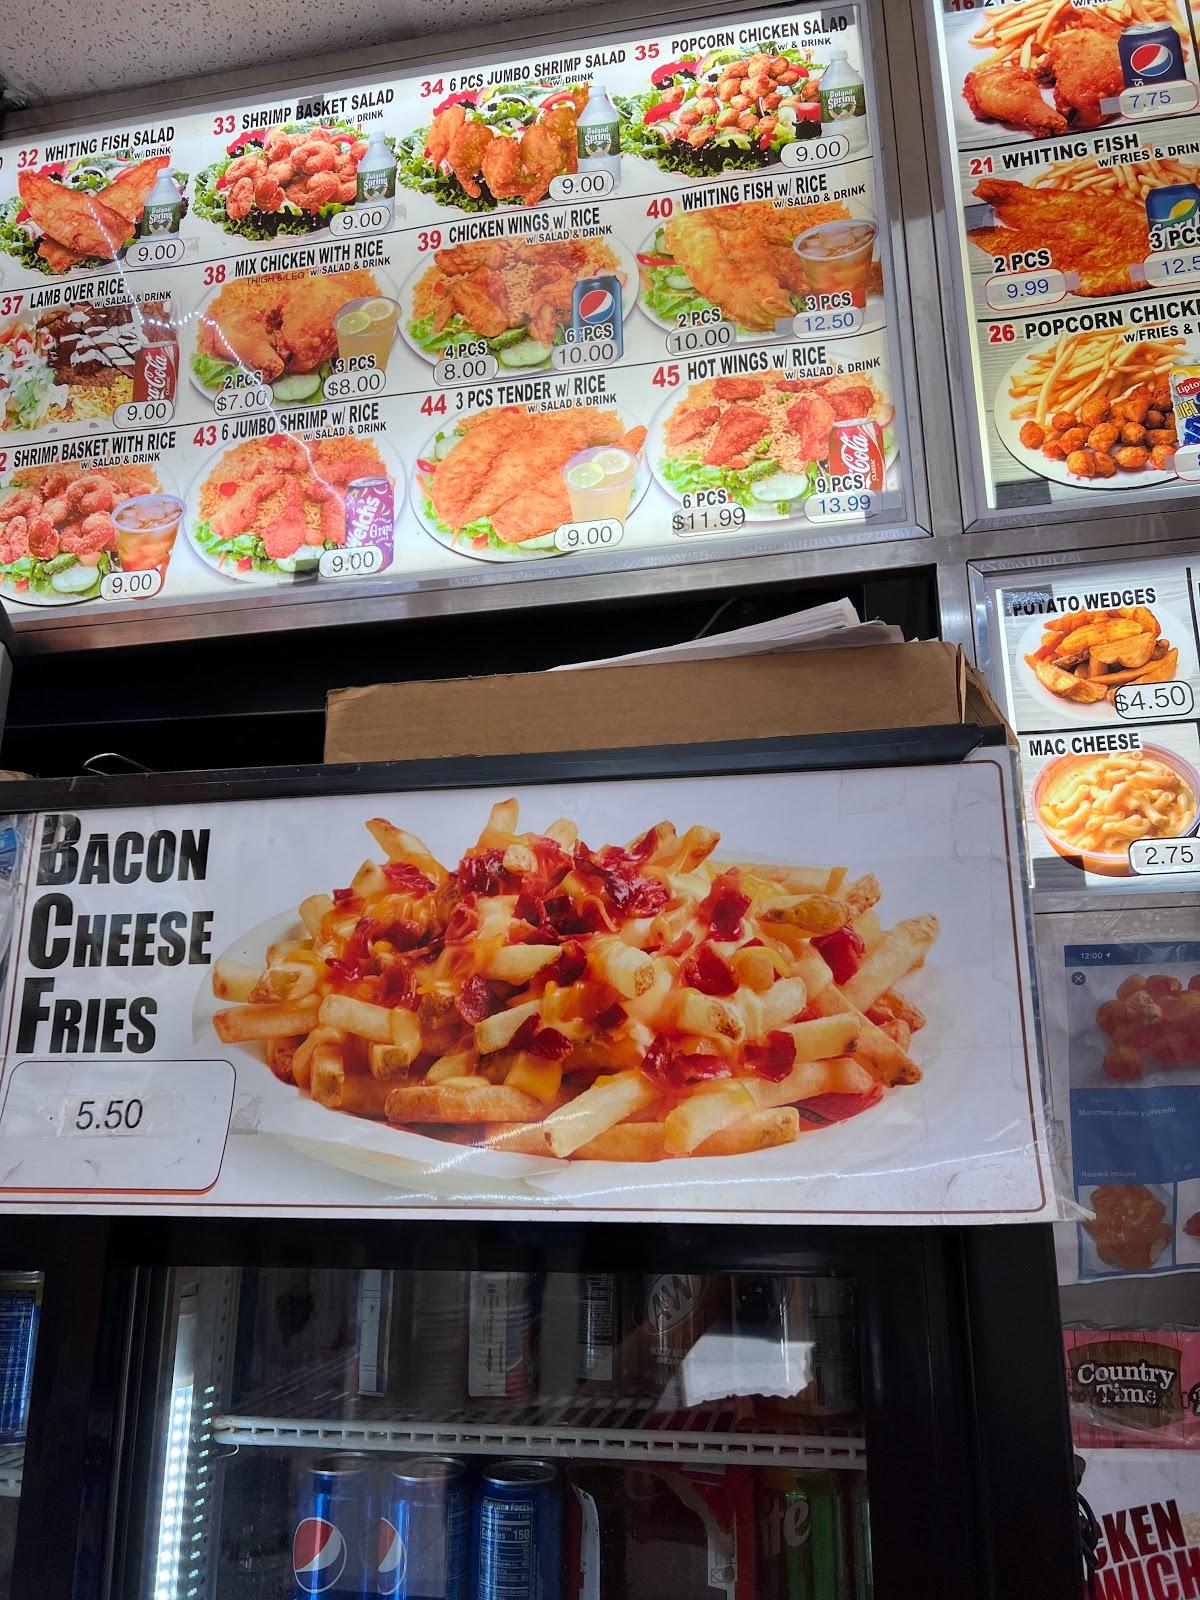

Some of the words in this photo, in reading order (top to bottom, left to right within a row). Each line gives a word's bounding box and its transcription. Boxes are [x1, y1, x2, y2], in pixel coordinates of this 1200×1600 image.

[634, 43, 660, 61] 35
[672, 31, 734, 55] POPCORN
[739, 22, 799, 44] CHICKEN
[804, 16, 847, 35] SALAD
[801, 36, 832, 47] DRINK
[420, 79, 444, 97] 34
[450, 77, 457, 91] 6
[460, 74, 483, 91] PCS
[487, 66, 530, 86] JUMBO
[534, 57, 581, 77] SHRIMP
[585, 50, 626, 68] SALAD
[565, 72, 594, 84] DRINK
[828, 95, 856, 108] Spring
[1129, 90, 1171, 109] 7.75
[213, 115, 236, 136] 33
[242, 107, 291, 129] SHRIMP
[296, 97, 347, 120] BASKET
[351, 88, 394, 110] SALAD
[357, 110, 384, 122] DRINK
[17, 149, 39, 168] 32
[45, 138, 97, 162] WHITING
[101, 133, 130, 152] FISH
[134, 126, 175, 146] SALAD
[145, 146, 171, 157] DRINK
[796, 141, 840, 162] 9.00
[970, 157, 994, 176] 21
[1002, 142, 1088, 170] WHITING
[1094, 134, 1139, 155] FISH
[1098, 150, 1151, 168] w/FRIES
[1154, 148, 1164, 158] &
[562, 175, 605, 195] 9.00
[646, 197, 673, 219] 40
[682, 186, 739, 211] WHITING
[743, 181, 774, 200] FISH
[795, 173, 827, 194] RICE
[787, 193, 820, 207] SALAD
[833, 184, 866, 200] DRINK
[343, 211, 382, 230] 9.00
[417, 230, 442, 251] 39
[449, 219, 504, 244] CHICKEN
[507, 213, 549, 235] WINGS
[553, 211, 567, 229] w/
[570, 207, 600, 227] RICE
[539, 230, 570, 243] SALAD
[582, 225, 612, 237] DRINK
[1150, 232, 1163, 249] 3
[138, 243, 176, 262] 9.00
[994, 258, 1006, 273] 2
[1011, 250, 1050, 271] PCS
[203, 264, 226, 286] 38
[235, 257, 257, 277] MIX
[260, 249, 315, 272] CHICKEN
[319, 244, 350, 265] WITH
[354, 240, 383, 258] RICE
[322, 263, 350, 275] SALAD
[362, 256, 391, 269] DRINK
[246, 275, 275, 286] THIGH
[286, 271, 304, 281] LEG
[1, 295, 24, 316] 37
[30, 288, 61, 308] LAMB
[64, 282, 94, 301] OVER
[97, 278, 125, 297] RICE
[105, 294, 133, 306] SALAD
[144, 291, 171, 302] DRINK
[1006, 279, 1049, 299] 9.99
[806, 296, 816, 311] 3
[821, 292, 851, 309] PCS
[678, 313, 687, 328] 2
[691, 308, 721, 325] PCS
[804, 312, 854, 332] 12.50
[989, 324, 1015, 343] 26
[1025, 310, 1123, 339] POPCORN
[566, 330, 575, 343] 6
[584, 325, 613, 341] PCS
[673, 327, 731, 351] 10.00
[1124, 325, 1179, 343] w/FRIES
[1183, 323, 1193, 335] &
[445, 345, 454, 358] 4
[458, 341, 486, 356] PCS
[559, 343, 614, 365] 10.00
[336, 359, 344, 372] 3
[349, 355, 375, 371] PCS
[444, 360, 486, 380] 8.00
[652, 365, 680, 388] 45
[688, 360, 716, 381] HOT
[721, 352, 768, 375] WINGS
[772, 349, 789, 369] w/
[792, 346, 827, 367] RICE
[799, 365, 833, 379] SALAD
[848, 357, 881, 373] DRINK
[224, 377, 232, 390] 2
[237, 371, 262, 387] PCS
[328, 374, 380, 397] $8.00
[216, 392, 266, 412] $7.00
[420, 394, 447, 417] 44
[455, 391, 463, 410] 3
[467, 388, 493, 408] PCS
[498, 381, 551, 405] TENDER
[555, 378, 570, 397] w/
[574, 374, 606, 395] RICE
[541, 399, 573, 412] SALAD
[586, 393, 617, 406] DRINK
[127, 402, 166, 421] 9.00
[193, 425, 217, 447] 43
[222, 427, 229, 441] 6
[232, 416, 276, 439] JUMBO
[280, 409, 328, 433] SHRIMP
[331, 406, 346, 425] w/
[349, 402, 379, 423] RICE
[315, 427, 345, 440] SALAD
[357, 422, 387, 434] DRINK
[14, 448, 58, 468] SHRIMP
[61, 438, 109, 461] BASKET
[112, 434, 144, 454] WITH
[147, 431, 176, 450] RICE
[92, 456, 121, 468] SALAD
[132, 452, 161, 463] DRINK
[817, 478, 826, 494] 9
[832, 475, 864, 491] PCS
[682, 494, 691, 509] 6
[696, 489, 727, 507] PCS
[819, 494, 871, 514] 13.99
[672, 507, 746, 531] $11.99
[567, 526, 612, 546] 9.00
[333, 551, 374, 573] 9.00
[112, 574, 152, 594] 9.00
[1014, 595, 1079, 616] POTATO
[1084, 587, 1156, 610] WEDGES
[1115, 685, 1186, 713] $4.50
[1029, 738, 1066, 756] MAC
[1071, 733, 1140, 754] CHEESE
[36, 814, 210, 886] BACON
[1145, 845, 1194, 865] 2.75
[28, 893, 214, 969] CHEESE
[1081, 952, 1103, 960] 12:00
[15, 977, 158, 1054] FRIES
[75, 1099, 143, 1129] 5.50
[1077, 1362, 1175, 1390] Country
[513, 1529, 530, 1541] 150
